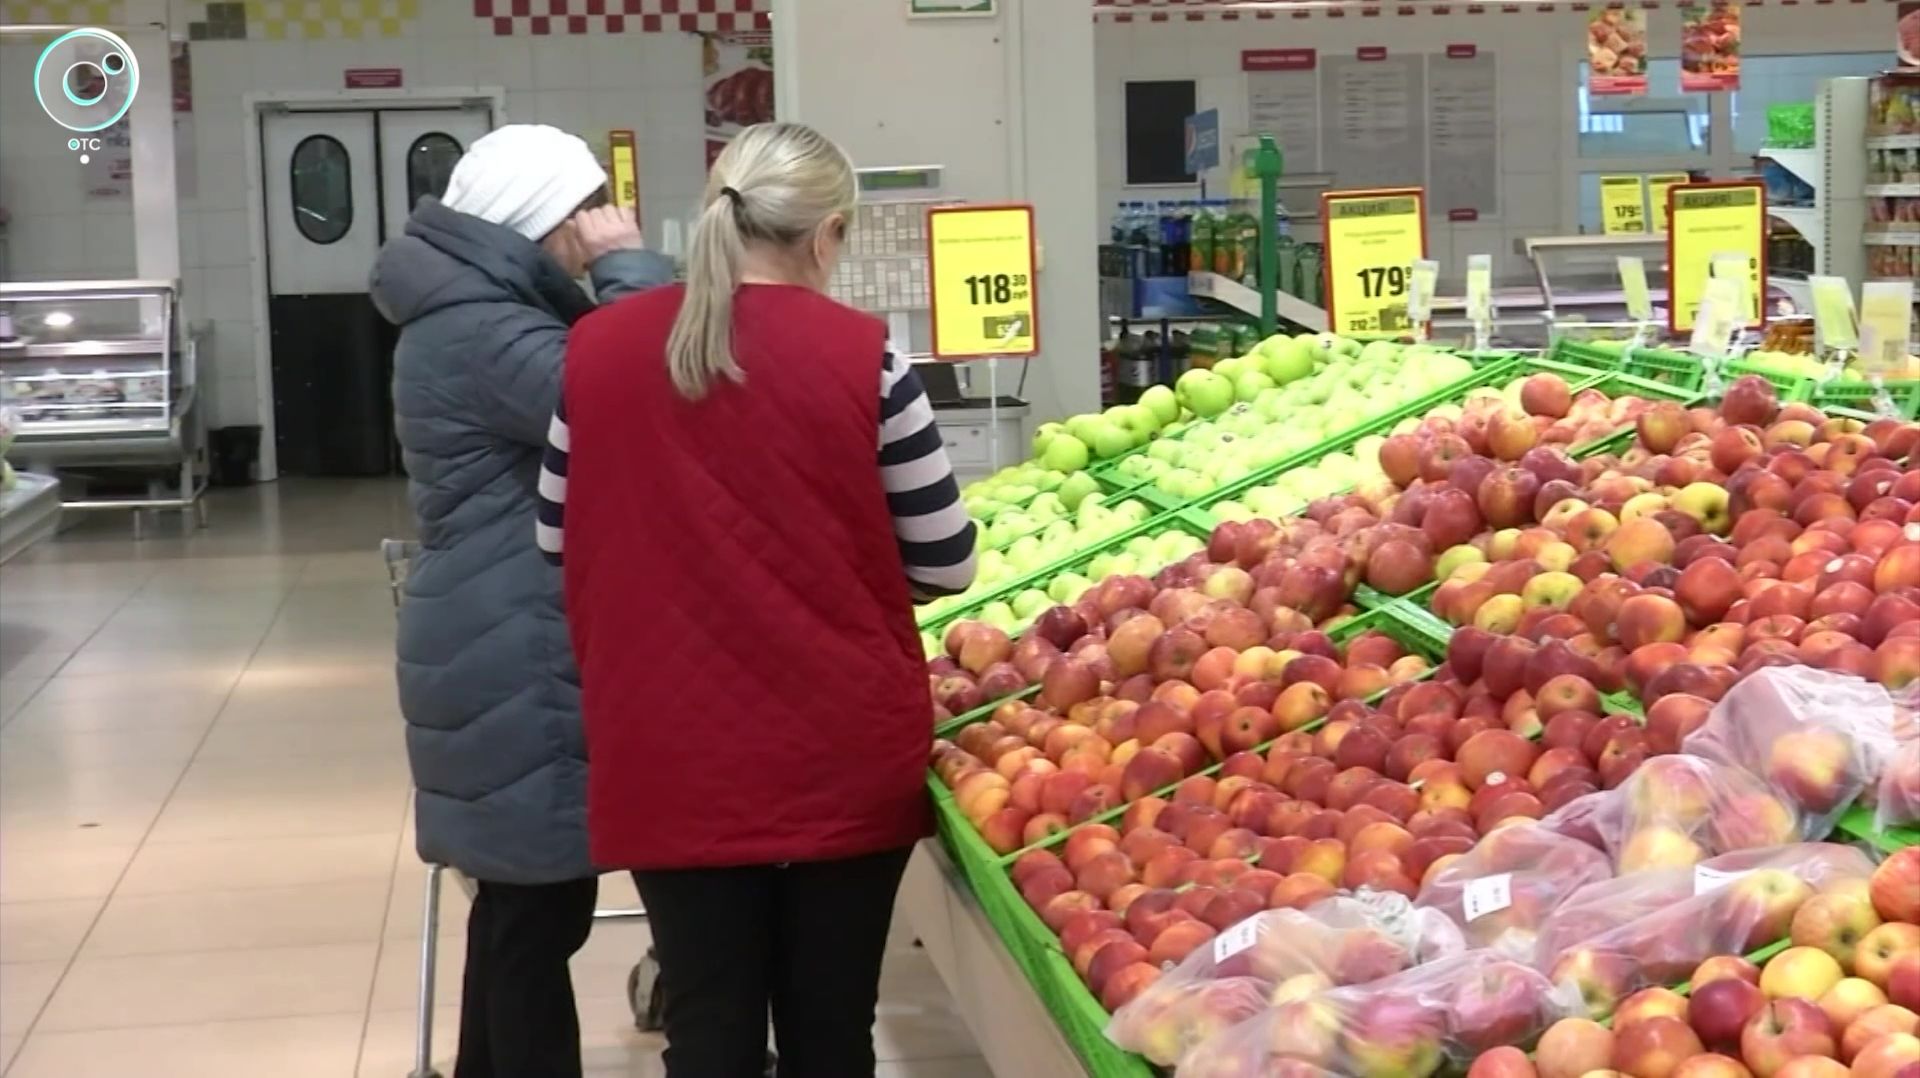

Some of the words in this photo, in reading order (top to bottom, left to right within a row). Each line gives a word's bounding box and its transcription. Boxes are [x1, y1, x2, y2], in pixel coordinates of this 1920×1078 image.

[964, 273, 1011, 305] 118
[1012, 274, 1027, 287] 30
[1356, 266, 1404, 298] 179
